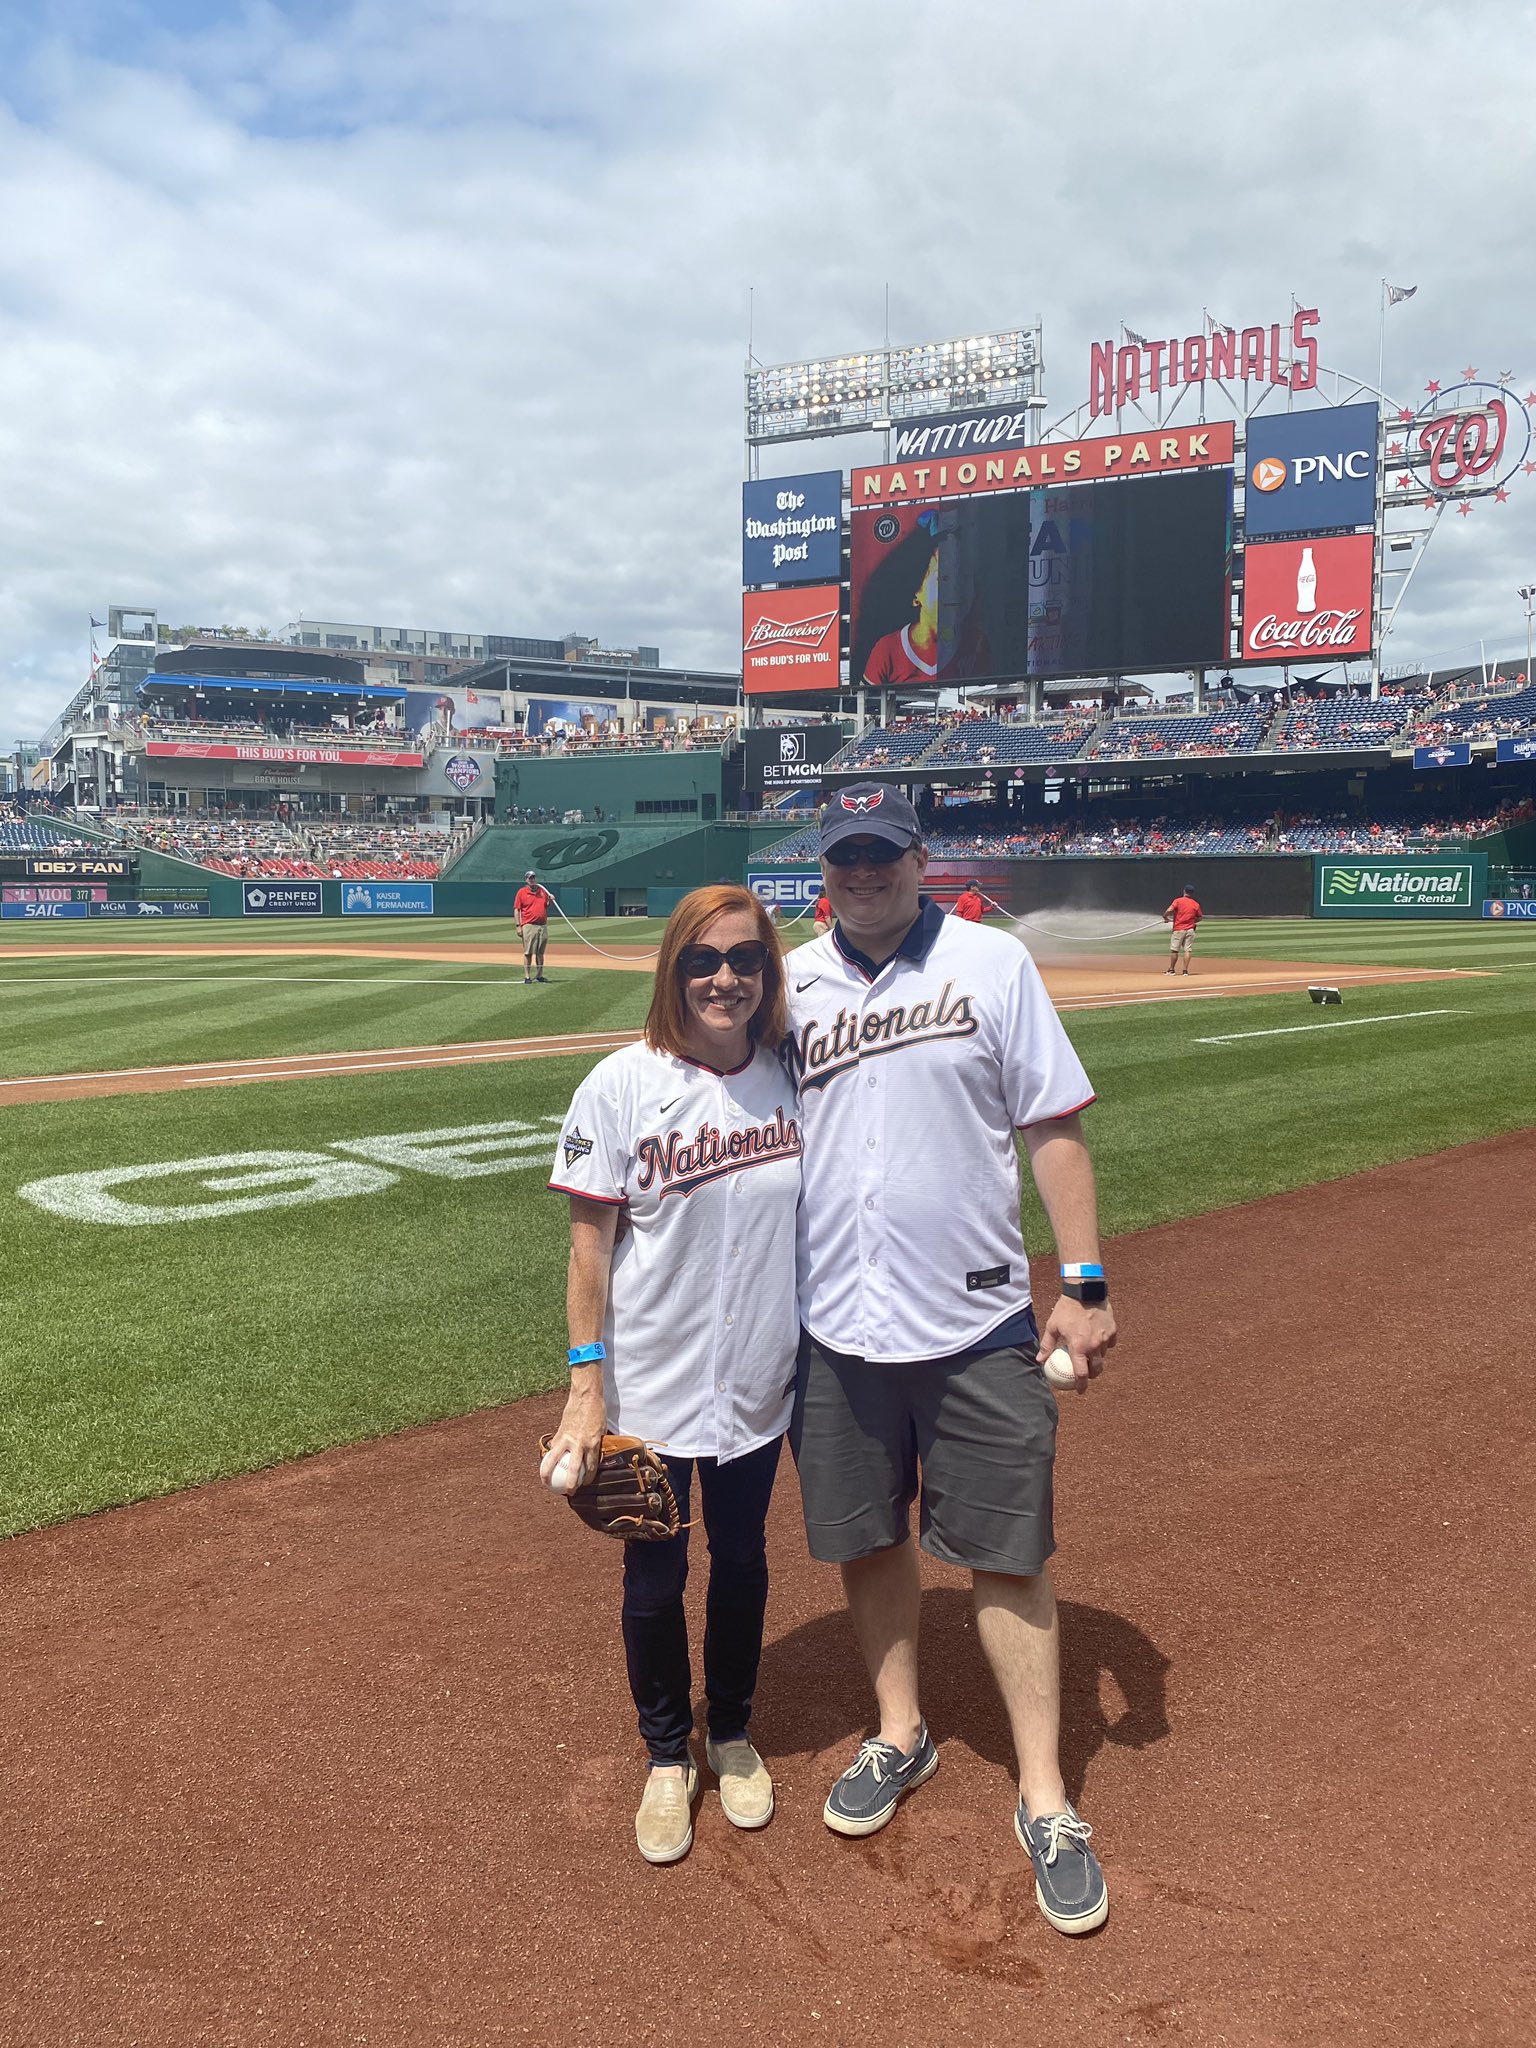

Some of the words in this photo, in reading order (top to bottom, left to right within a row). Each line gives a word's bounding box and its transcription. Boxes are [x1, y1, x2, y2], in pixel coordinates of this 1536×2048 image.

[1090, 308, 1320, 417] NATIONALS
[896, 412, 1025, 456] NATITUDE
[864, 450, 1081, 496] NATIONALS
[1104, 433, 1209, 466] PARK
[1291, 451, 1370, 484] PNC
[776, 491, 805, 511] The
[746, 515, 837, 540] Washington
[773, 542, 808, 568] Post
[751, 623, 828, 641] Budweiser
[1249, 608, 1364, 650] Coca-Cola
[750, 657, 768, 667] THIS
[770, 655, 794, 665] BUD'S
[795, 654, 811, 664] FOR
[812, 652, 831, 662] YOU.
[1347, 671, 1381, 684] SHAK
[1384, 663, 1422, 680] SHACK
[235, 747, 260, 758] THIS
[262, 748, 294, 760] BUD'S
[296, 750, 317, 760] FOR
[318, 751, 343, 761] YOU.
[446, 767, 480, 776] CHAMPIONS
[763, 763, 822, 777] BETMGM
[254, 775, 276, 784] BREW
[81, 862, 123, 873] FAN
[76, 890, 88, 900] 377
[268, 892, 317, 901] PENFED
[376, 892, 401, 900] KAISER
[752, 880, 823, 900] GEIC
[1393, 894, 1414, 903] Car
[1417, 894, 1456, 903] Rental
[24, 904, 64, 917] SAIC
[100, 903, 126, 911] MGM
[173, 902, 199, 911] MGM
[1506, 902, 1536, 916] PNC
[779, 978, 980, 1082] Nationals
[638, 1105, 801, 1193] Nationals
[17, 1115, 575, 1227] GE
